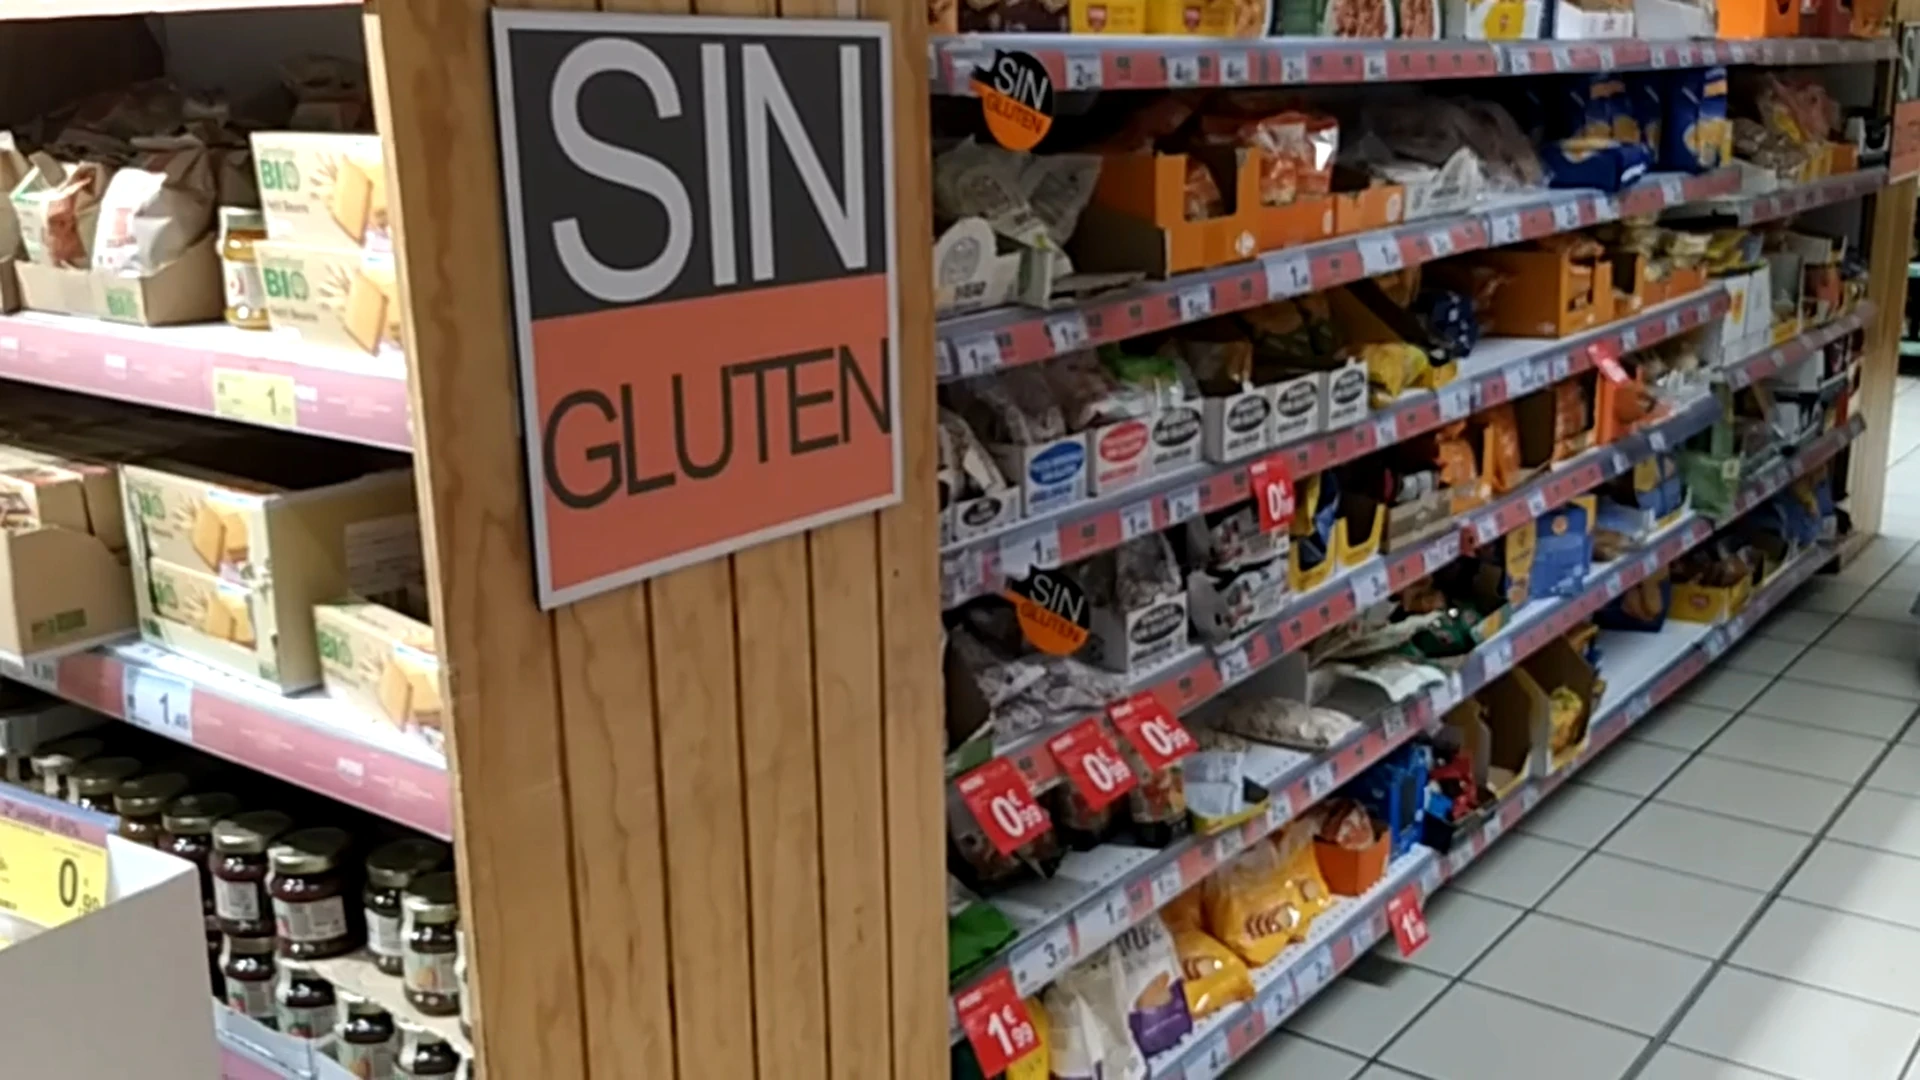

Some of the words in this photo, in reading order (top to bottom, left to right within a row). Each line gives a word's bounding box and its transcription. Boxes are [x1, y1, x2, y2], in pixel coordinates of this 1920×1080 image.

[994, 56, 1048, 112] SIN
[985, 92, 1043, 135] GLUTEN
[259, 158, 301, 193] BIO
[550, 36, 868, 302] SIN
[263, 266, 310, 302] BIO
[542, 336, 892, 509] GLUTEN
[1020, 601, 1081, 643] GLUTEN
[1029, 573, 1084, 626] SIN
[58, 857, 79, 908] 0
